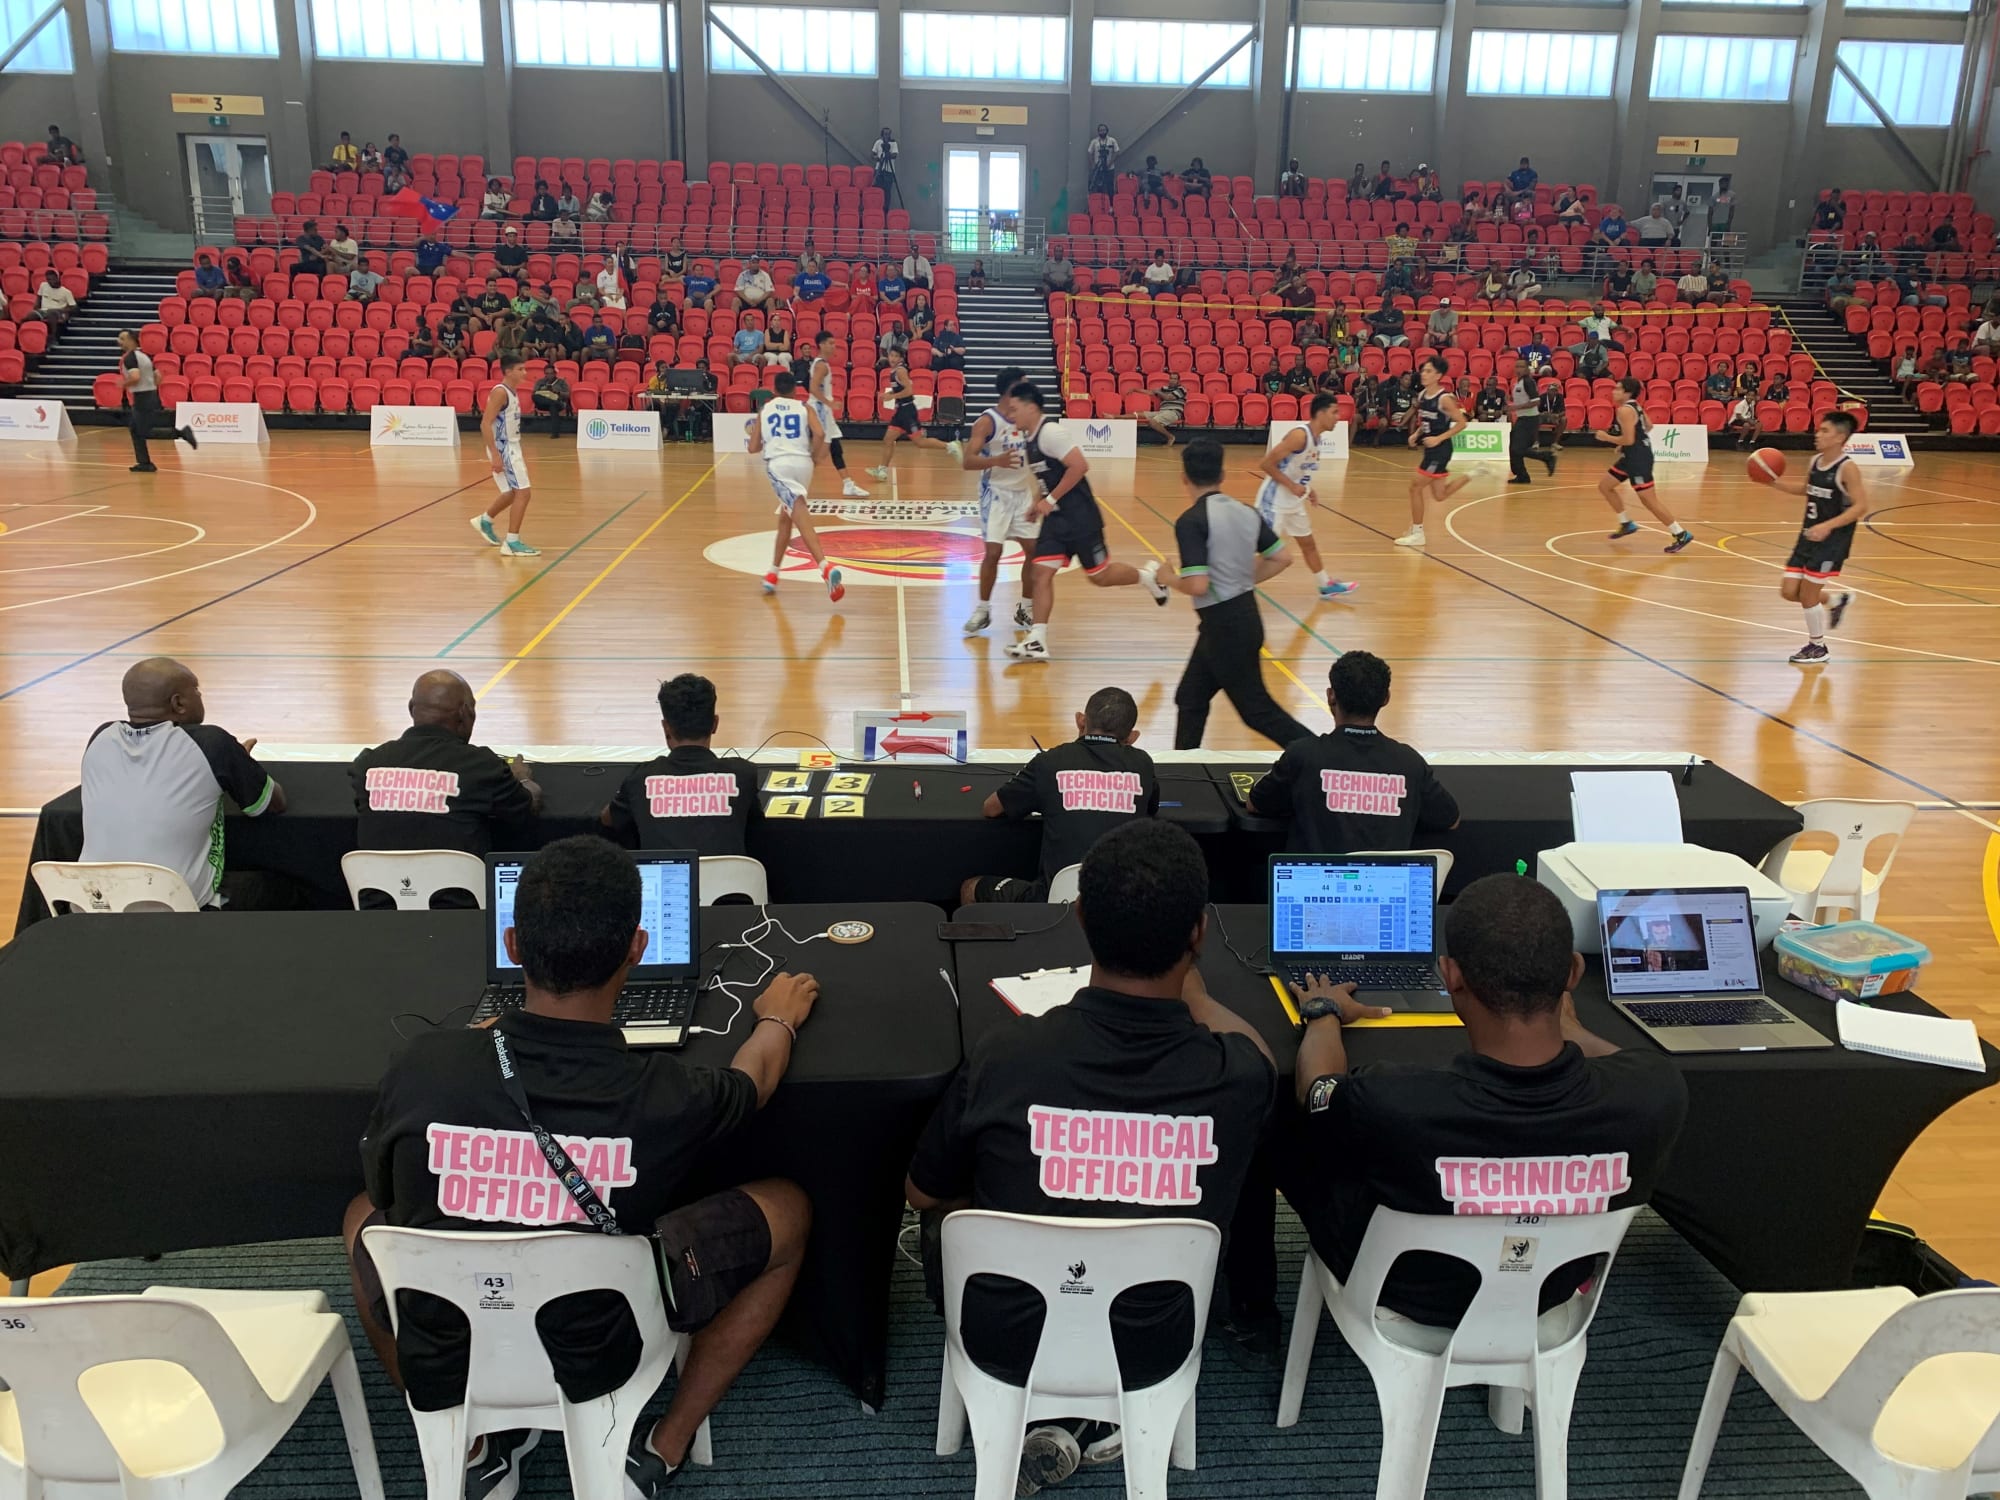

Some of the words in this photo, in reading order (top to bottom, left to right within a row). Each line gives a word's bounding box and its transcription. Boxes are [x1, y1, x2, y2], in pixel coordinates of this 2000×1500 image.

[213, 96, 223, 111] 3
[980, 107, 990, 122] 2
[1694, 139, 1700, 153] 1
[207, 413, 240, 423] GORE
[767, 412, 801, 439] 29
[610, 423, 651, 433] Telikom
[1466, 434, 1498, 449] BSP
[1654, 450, 1679, 458] Holiday
[808, 754, 833, 768] 5
[366, 768, 459, 795] TECHNICAL
[645, 774, 738, 796] TECHNICAL
[773, 776, 802, 788] 4
[834, 776, 862, 789] 3
[1057, 771, 1142, 794] TECHNICAL
[1321, 769, 1406, 796] TECHNICAL
[370, 790, 449, 813] OFFICIAL
[652, 796, 731, 815] OFFICIAL
[776, 801, 802, 815] 1
[829, 800, 855, 814] 2
[1063, 792, 1135, 813] OFFICIAL
[1327, 794, 1400, 816] OFFICIAL
[494, 1036, 515, 1080] Basketball
[1031, 1111, 1214, 1160] TECHNICAL
[431, 1129, 632, 1183] TECHNCAL
[1044, 1155, 1197, 1200] OFFICIAL
[1440, 1156, 1628, 1197] TECHNICAL
[443, 1174, 604, 1222] OFFICIA
[1514, 1216, 1540, 1225] 140
[483, 1277, 505, 1288] 43
[1, 1317, 26, 1330] 36
